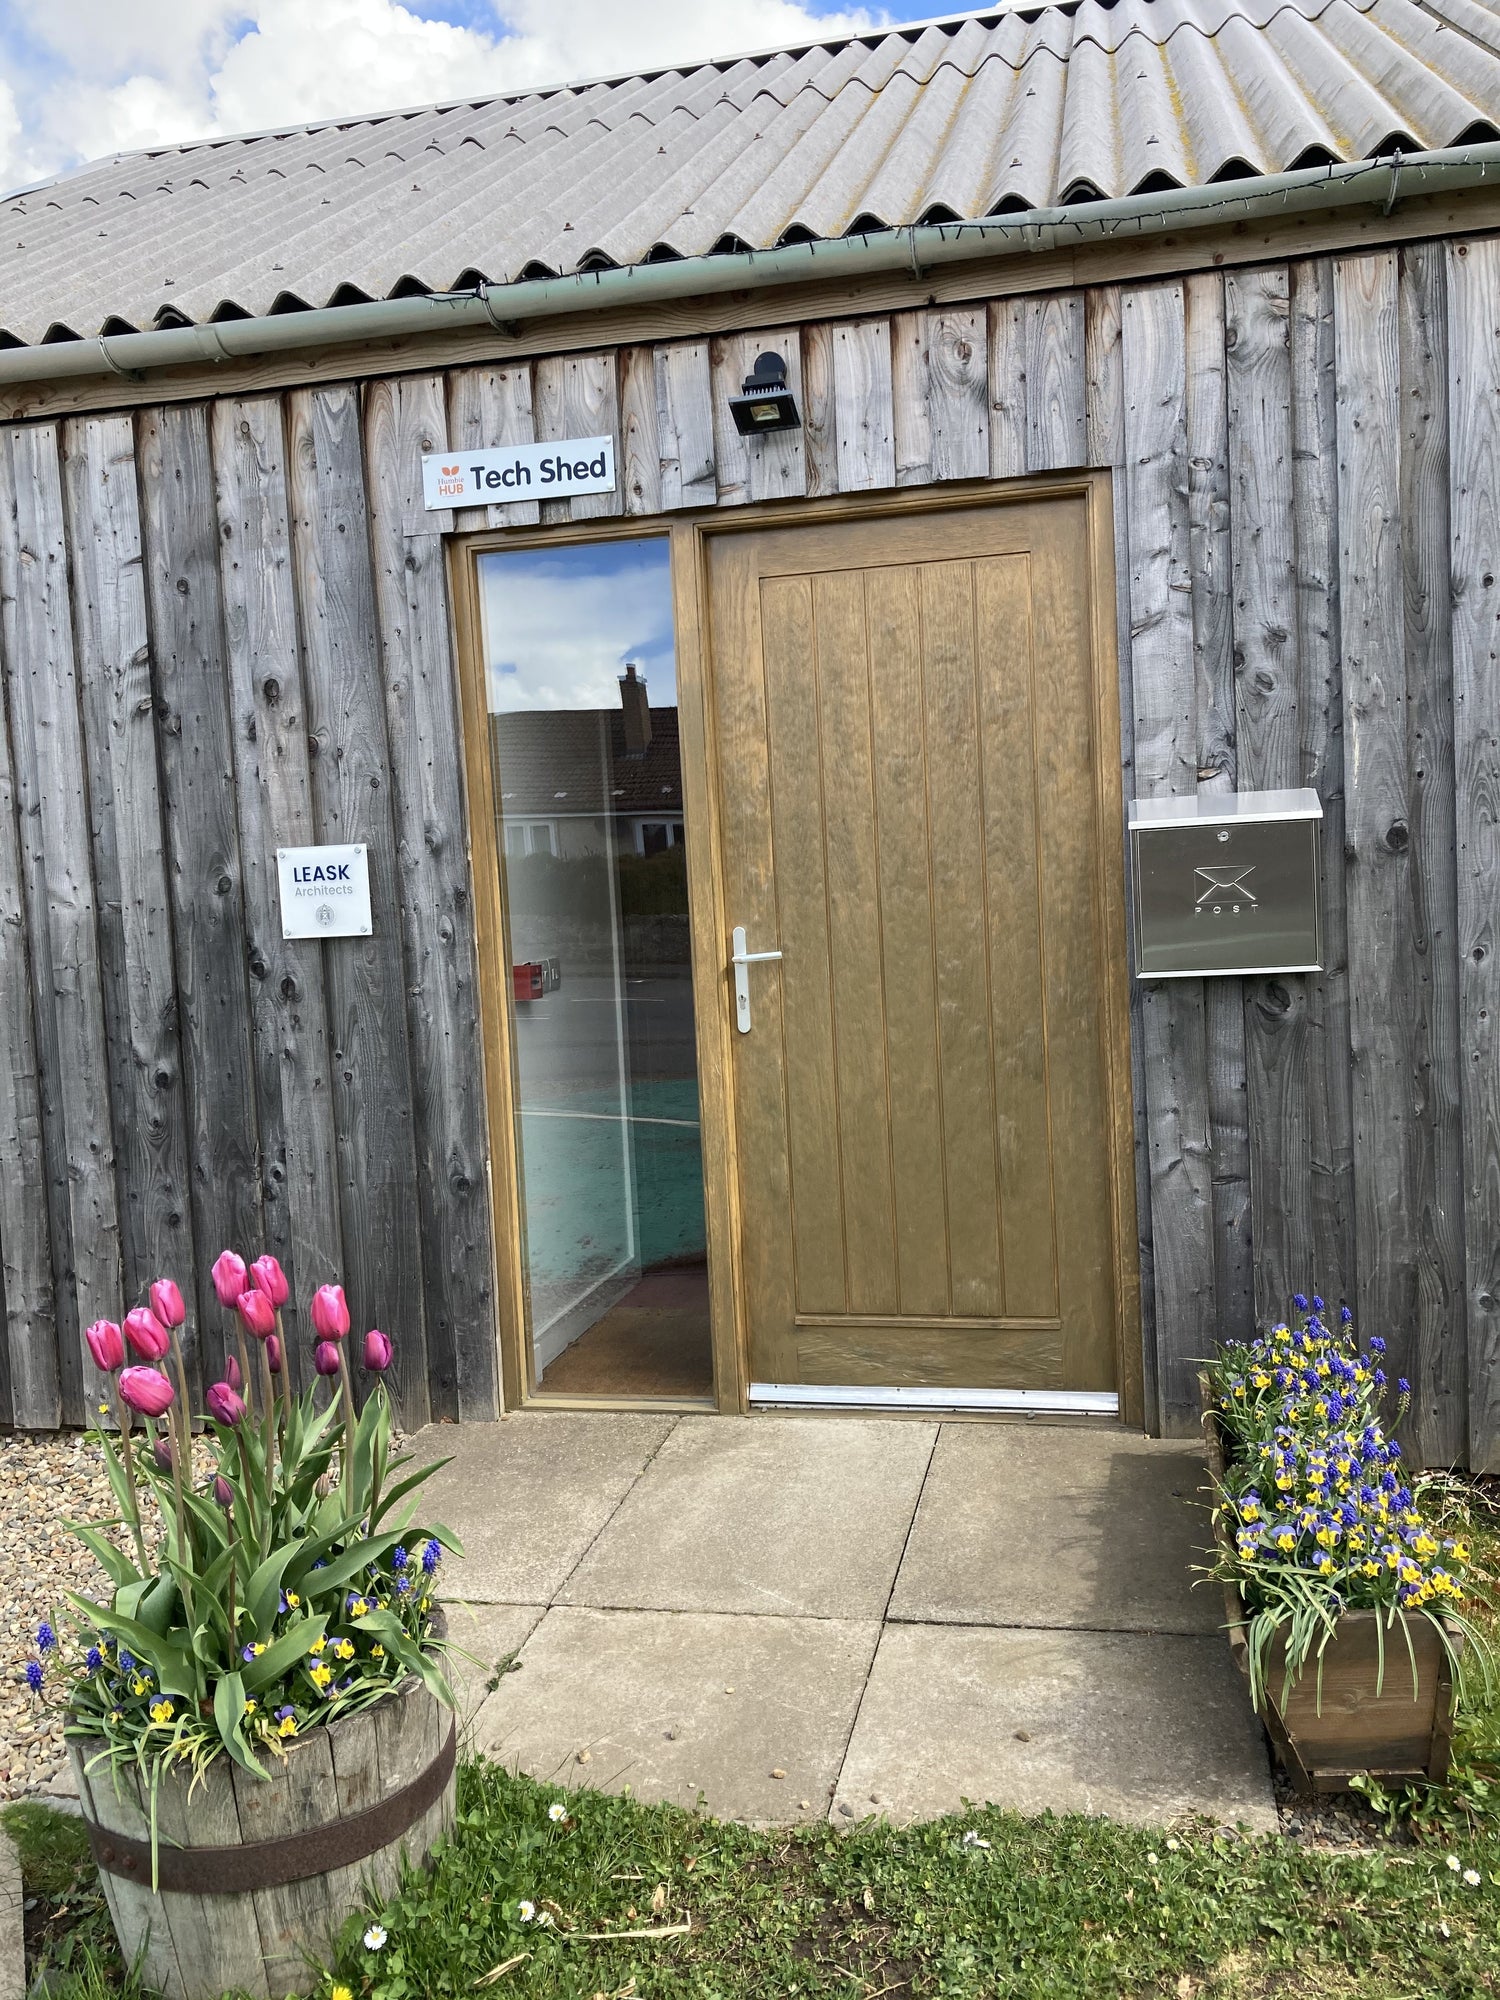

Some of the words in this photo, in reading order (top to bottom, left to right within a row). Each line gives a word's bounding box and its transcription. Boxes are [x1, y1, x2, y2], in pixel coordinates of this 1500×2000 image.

[470, 460, 531, 490] Tech
[539, 451, 606, 483] Shed
[439, 483, 464, 496] HUB
[293, 864, 351, 883] LEASK
[294, 885, 353, 897] Architects
[1194, 904, 1259, 916] POST
